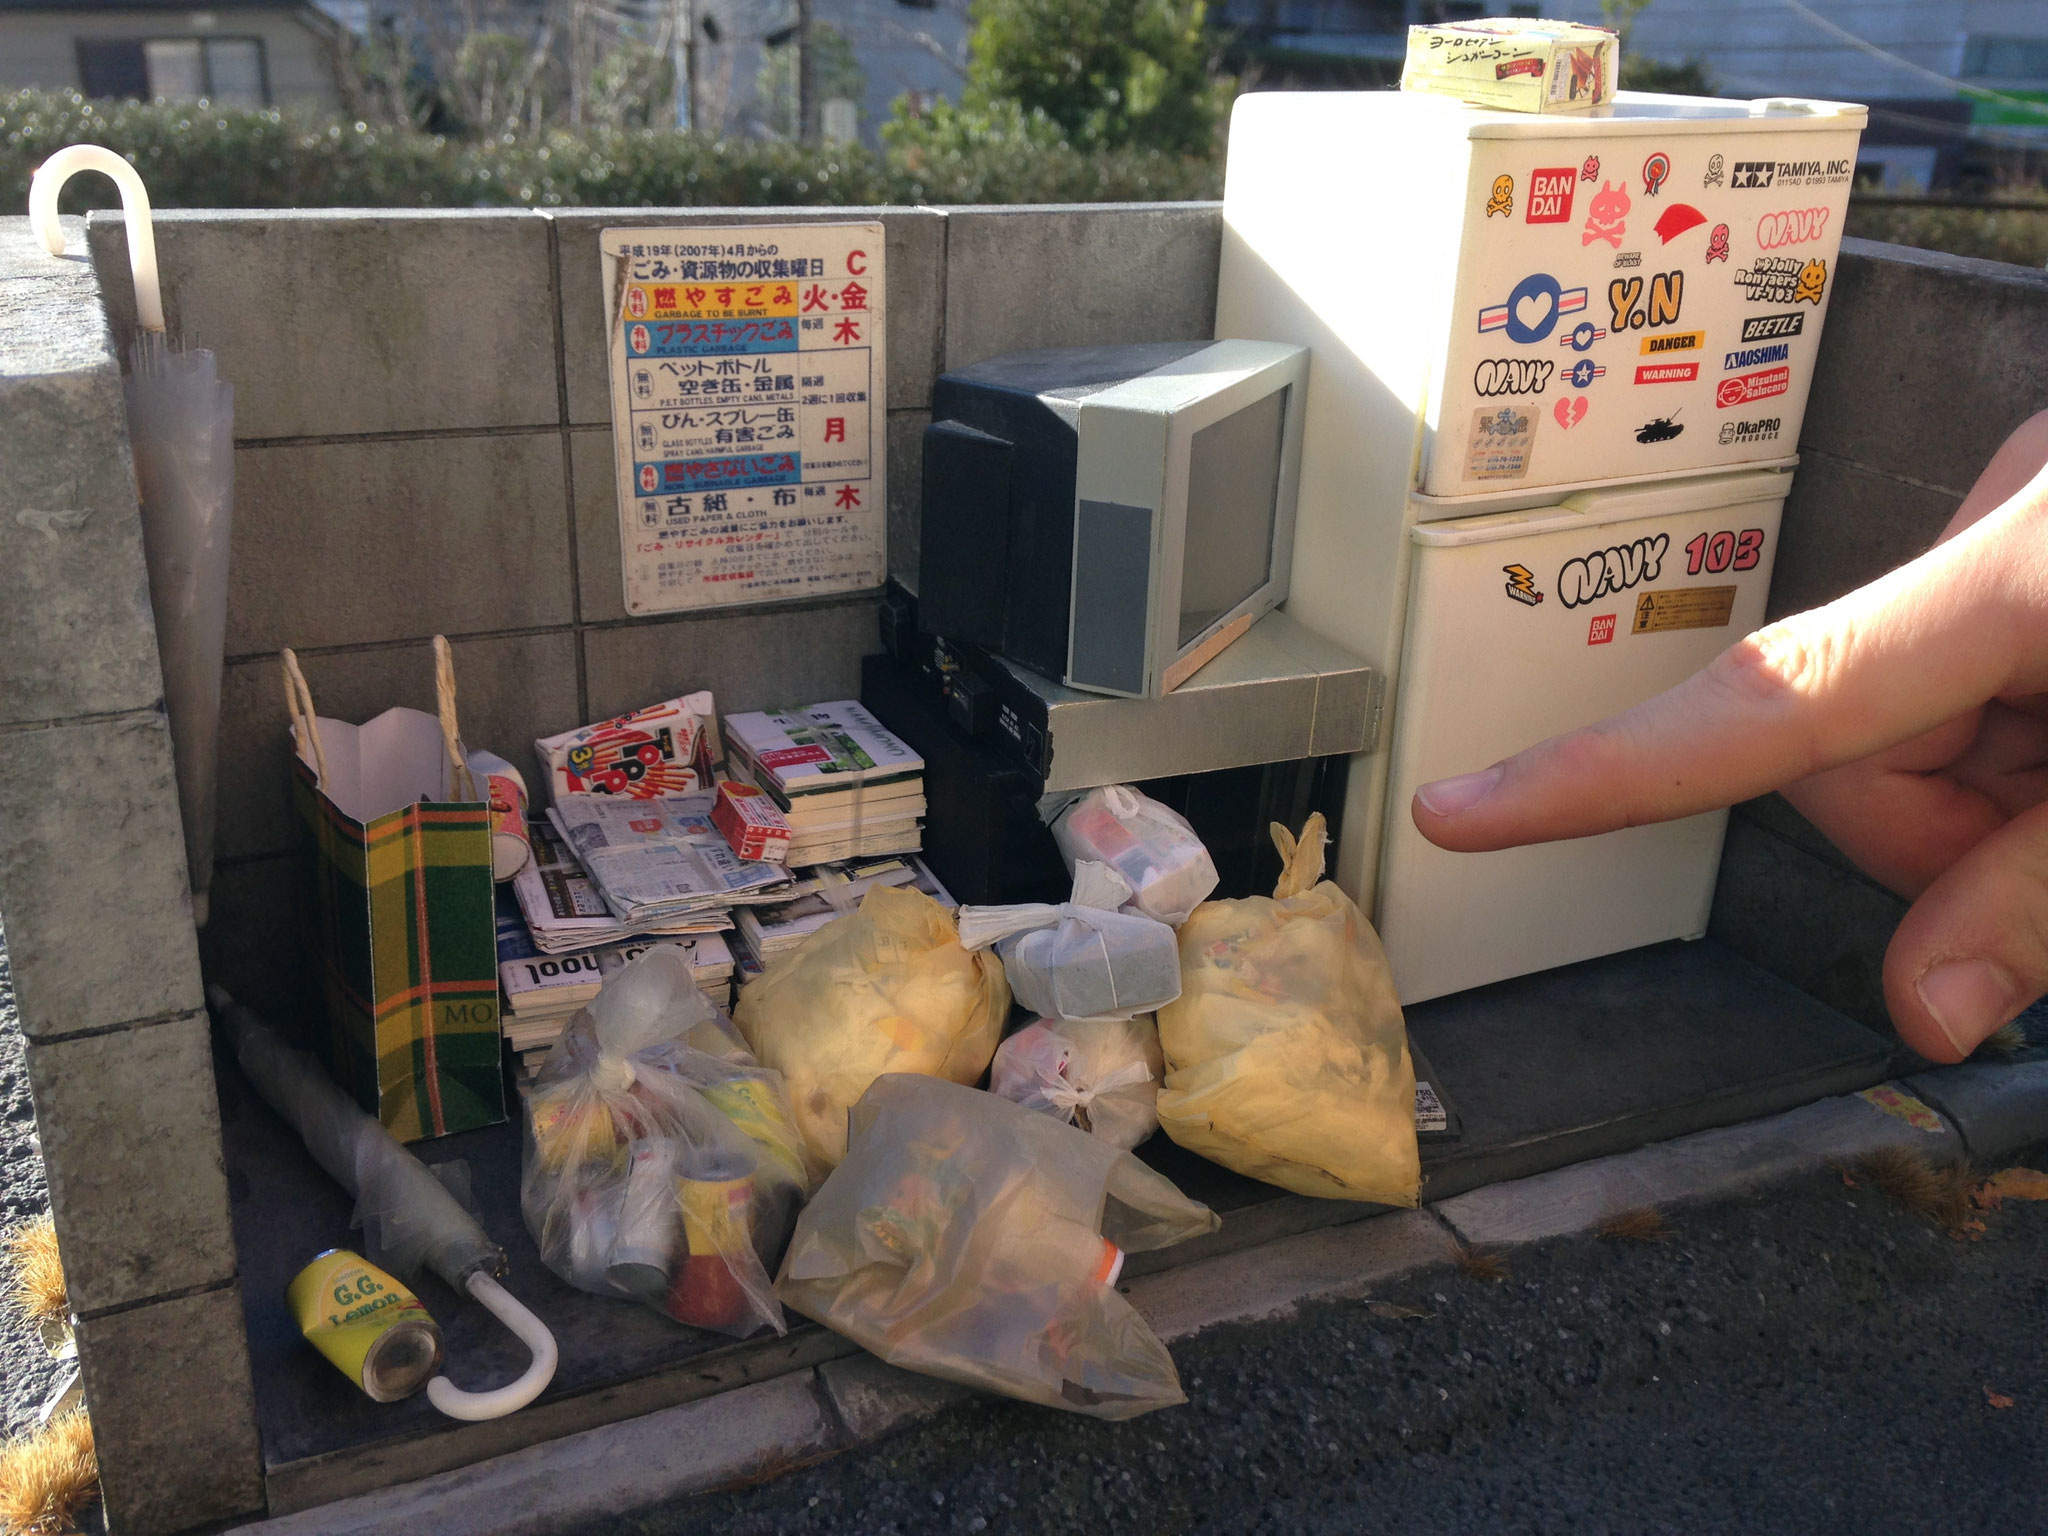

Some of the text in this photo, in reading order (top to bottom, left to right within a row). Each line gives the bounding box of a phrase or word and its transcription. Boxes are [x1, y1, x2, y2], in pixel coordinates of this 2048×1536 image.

[1777, 159, 1851, 178] TAMIYA, INC.
[1533, 176, 1572, 196] BAN
[1530, 196, 1562, 216] DAI
[1757, 207, 1830, 250] NAVY
[633, 257, 824, 280] ごみ・資源物の収集曜日
[846, 250, 867, 275] C
[653, 285, 793, 308] 燃やすごみ
[802, 281, 868, 312] 火・金
[1609, 270, 1684, 333] Y.N
[1746, 285, 1796, 303] VF-103
[654, 308, 767, 319] GARBAGE TO BE BURNT
[656, 322, 793, 343] プラスチックごみ
[833, 317, 861, 345] 木
[1744, 315, 1802, 340] BEETLE
[657, 344, 748, 354] PLASTIC GARBAGE
[1649, 335, 1696, 352] DANGER
[1738, 344, 1789, 367] AOSHIMA
[1474, 358, 1554, 397] NAVY
[1642, 368, 1692, 380] WARNING
[1747, 369, 1788, 387] Mizutani
[678, 375, 795, 396] 空き缶・金属
[765, 392, 794, 402] METALS
[715, 425, 795, 444] 有害ごみ
[824, 417, 845, 443] 月
[1736, 417, 1781, 436] OkaPRO
[663, 437, 713, 448] GLASS BOTTLES
[1735, 431, 1780, 444] PRODUCE
[834, 484, 861, 510] 木
[666, 509, 767, 526] USED PAPER & CLOTH
[1558, 529, 1765, 609] NAVY 103
[1592, 618, 1614, 631] BAN
[1590, 630, 1608, 641] DAI
[446, 1002, 498, 1025] MO
[334, 1274, 384, 1306] G.G.
